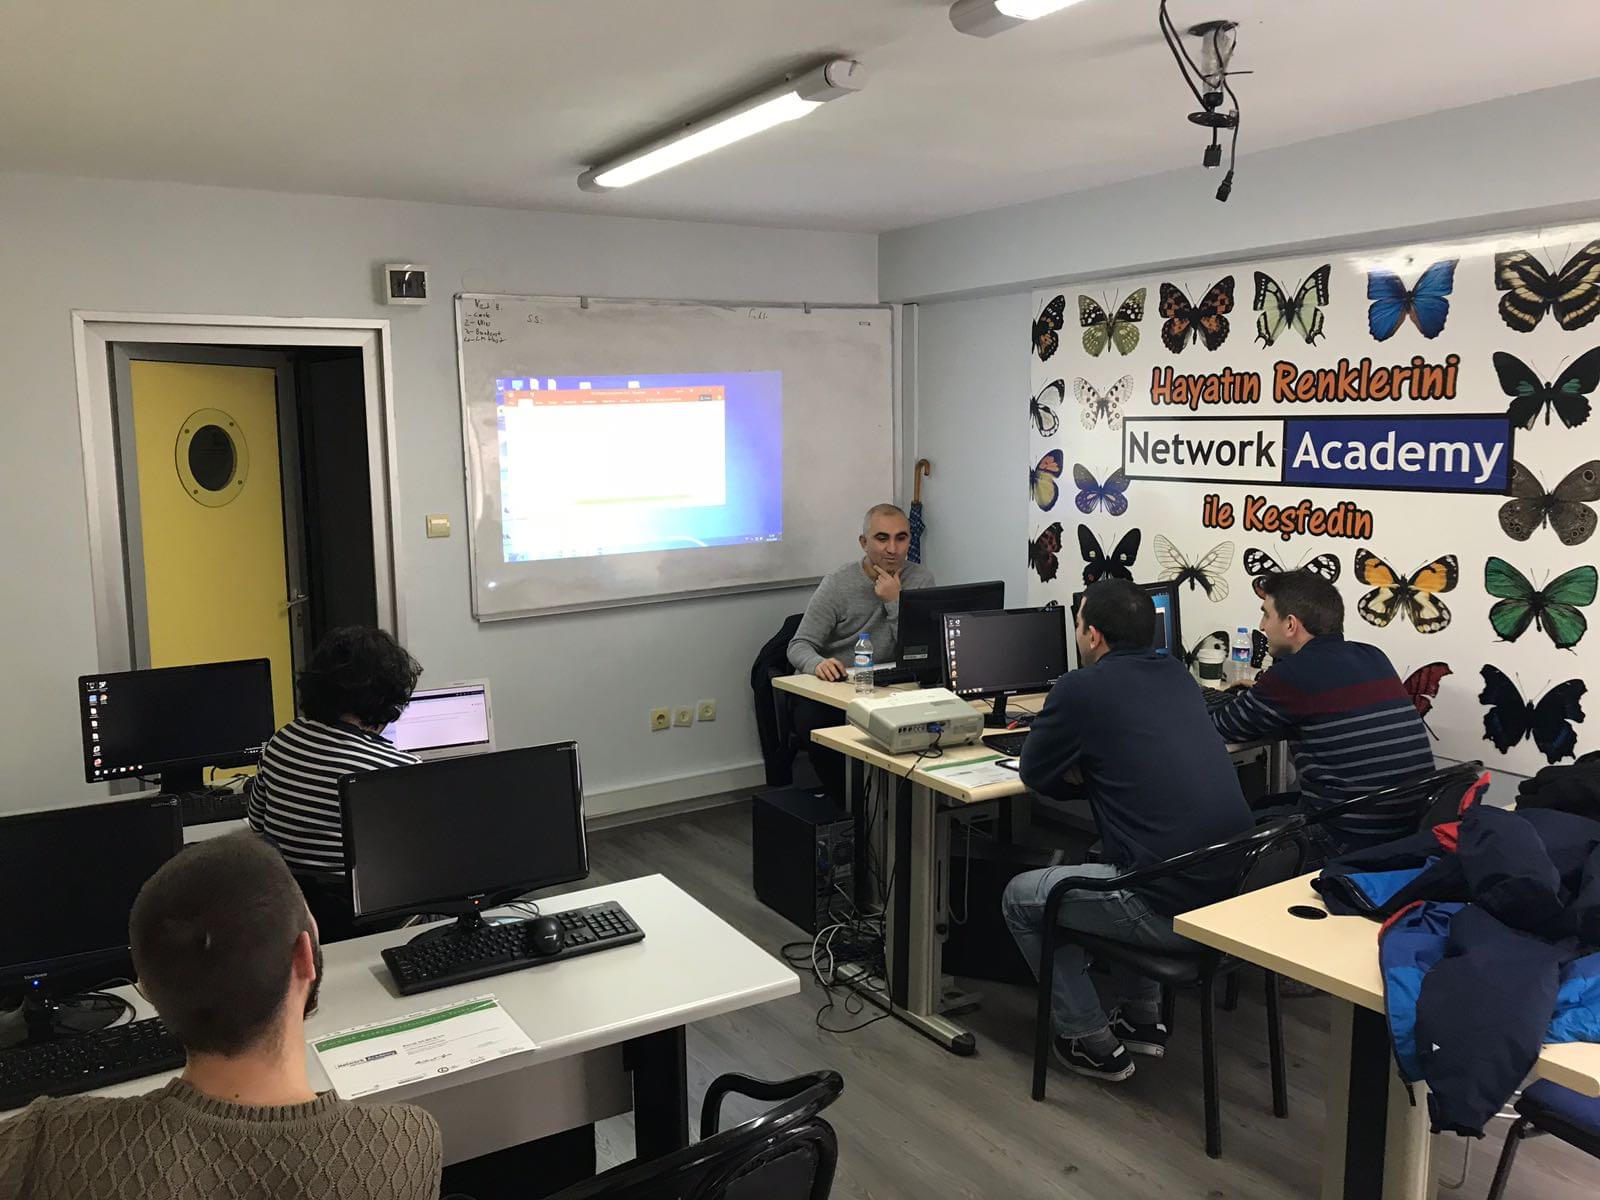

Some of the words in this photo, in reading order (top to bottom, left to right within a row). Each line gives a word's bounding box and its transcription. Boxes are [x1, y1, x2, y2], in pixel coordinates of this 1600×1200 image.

[1150, 366, 1261, 411] Hayatın
[1273, 353, 1461, 404] Renklerini
[1129, 431, 1276, 467] Network
[1291, 431, 1505, 484] Academy
[1202, 493, 1235, 529] ile
[1243, 494, 1373, 541] Keşfedin
